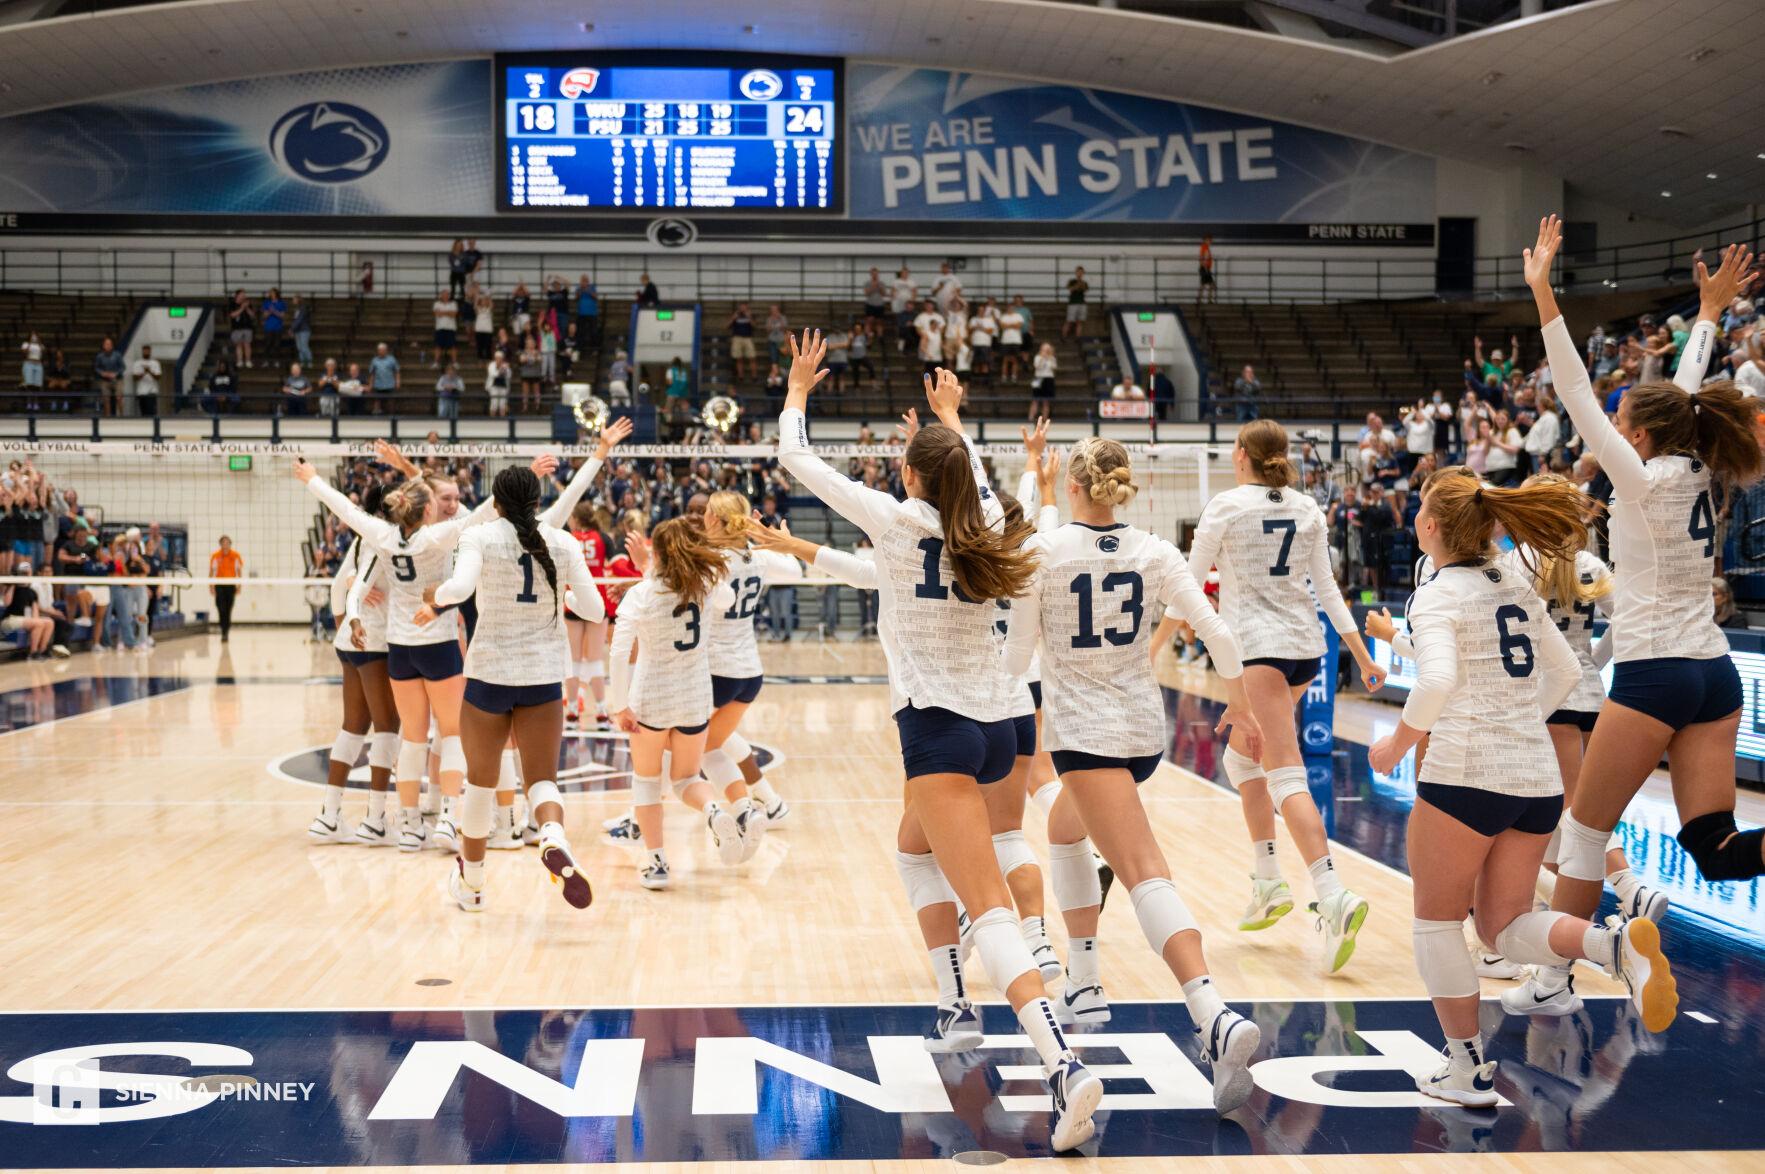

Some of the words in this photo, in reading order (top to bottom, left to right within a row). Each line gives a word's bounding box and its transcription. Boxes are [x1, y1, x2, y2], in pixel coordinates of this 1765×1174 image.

[520, 105, 555, 130] 18
[786, 107, 823, 132] 24
[857, 123, 913, 153] WE
[924, 117, 995, 148] ARE
[881, 144, 1059, 208] PENN
[1077, 127, 1278, 193] STATE
[1308, 225, 1351, 239] PENN
[1356, 225, 1406, 239] STATE
[3, 441, 89, 452] VOLLEYBALL
[134, 443, 170, 453] PENN
[175, 443, 215, 453] STATE
[220, 443, 304, 453] VOLLEYBALL
[434, 444, 518, 454] VOLLEYBALL
[646, 445, 729, 455] VOLLEYBALL
[813, 445, 852, 455] STATE
[982, 445, 1018, 454] PENN
[1687, 490, 1716, 559] 4
[1262, 519, 1297, 576] 7
[391, 554, 417, 582] 9
[516, 553, 539, 603] 1
[724, 575, 762, 620] 12
[1070, 571, 1144, 648] 13
[673, 601, 701, 652] 3
[1495, 604, 1534, 678] 6
